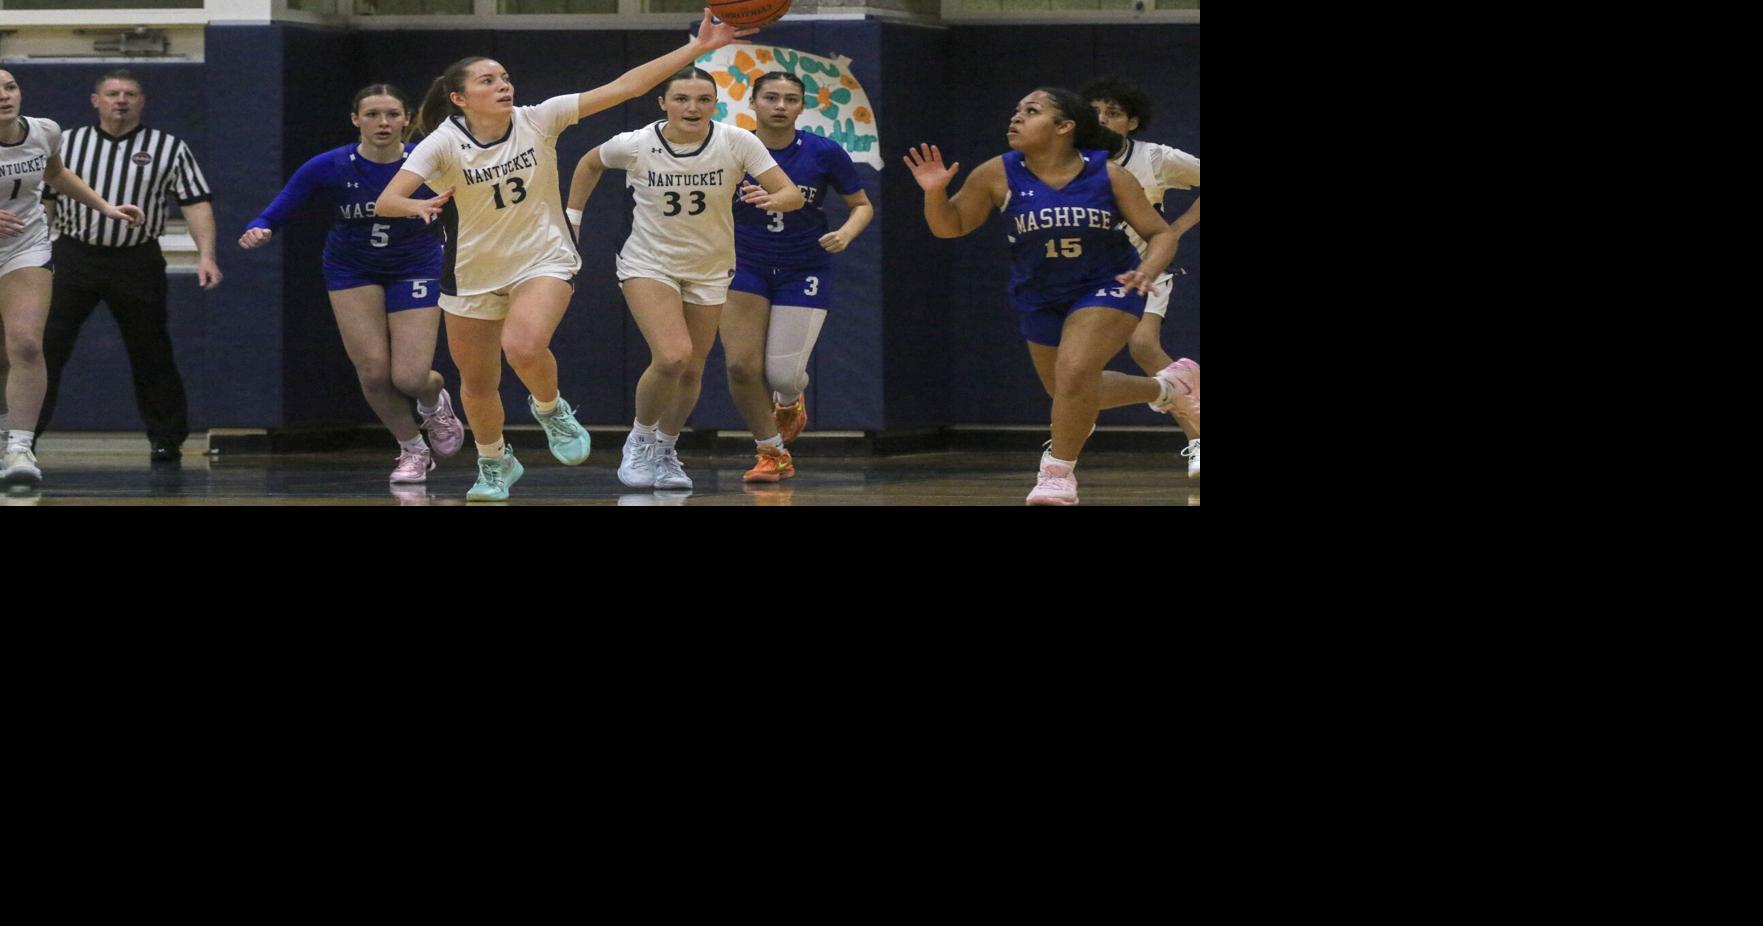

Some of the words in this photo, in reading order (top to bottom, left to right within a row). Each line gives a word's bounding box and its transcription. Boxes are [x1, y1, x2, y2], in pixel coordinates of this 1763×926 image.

[0, 154, 47, 178] NTUCKET
[462, 148, 538, 186] NANTUCKET
[647, 169, 724, 187] NANTUCKET
[491, 176, 527, 210] 13
[663, 190, 706, 217] 33
[766, 210, 785, 233] 3
[1014, 207, 1112, 235] MASHPEE
[370, 222, 391, 248] 5
[1045, 237, 1083, 259] 15
[412, 281, 428, 298] 5
[803, 276, 820, 297] 3
